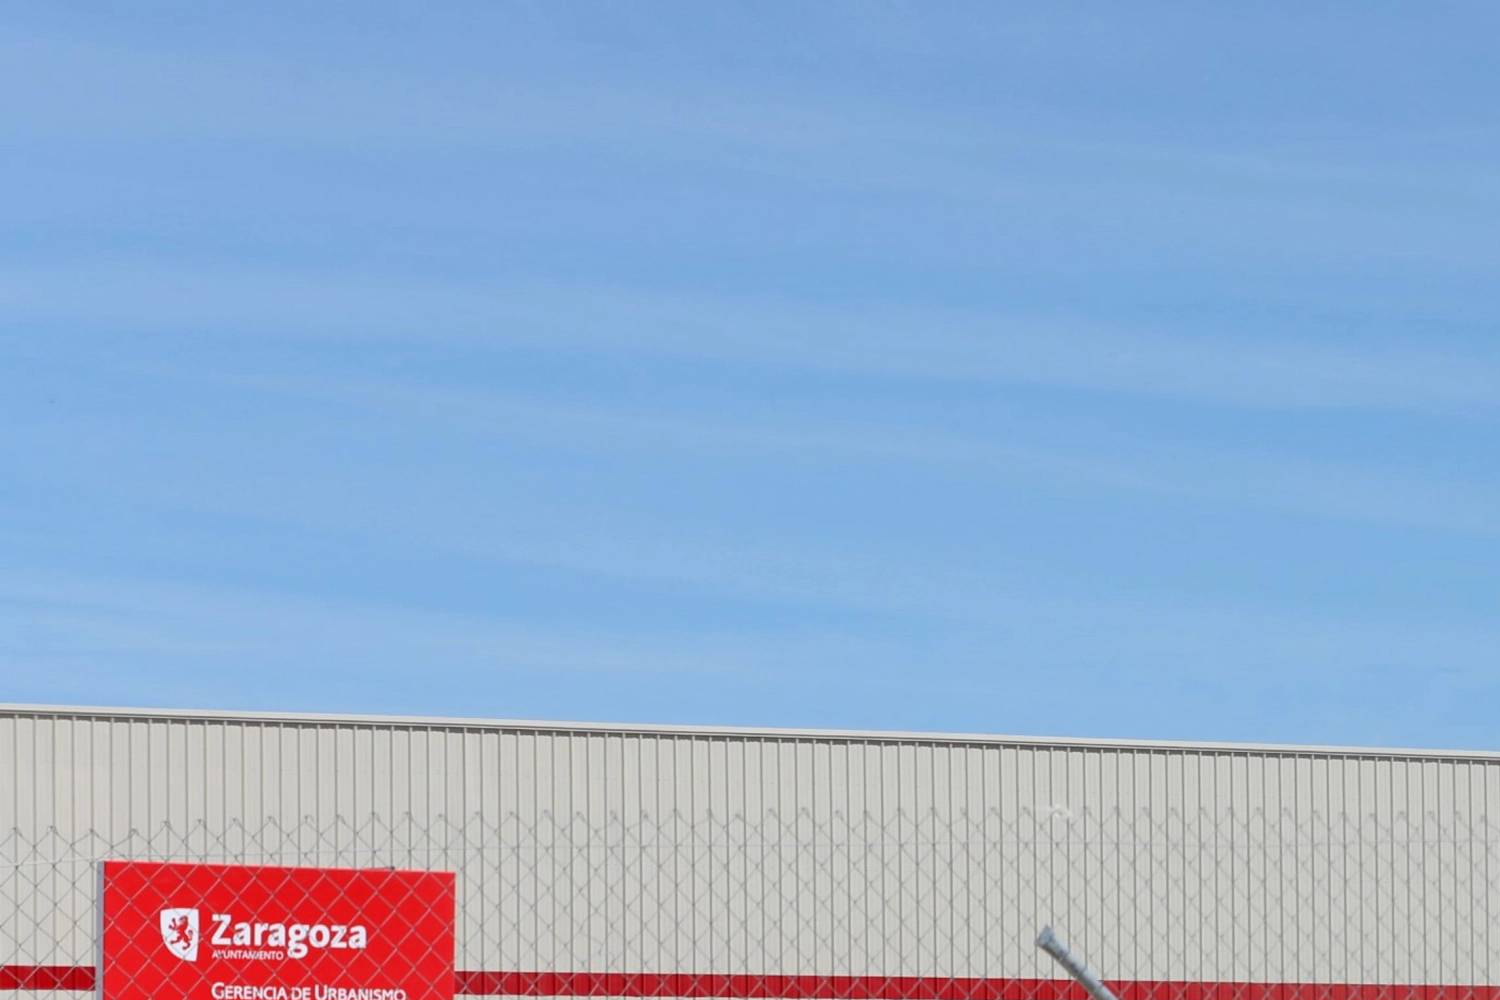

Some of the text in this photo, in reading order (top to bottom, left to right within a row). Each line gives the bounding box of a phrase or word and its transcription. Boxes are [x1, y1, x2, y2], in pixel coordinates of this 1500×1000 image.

[211, 914, 367, 958] Zaragoza
[212, 950, 284, 961] AYUNTAMIENTO
[292, 988, 310, 1000] DE
